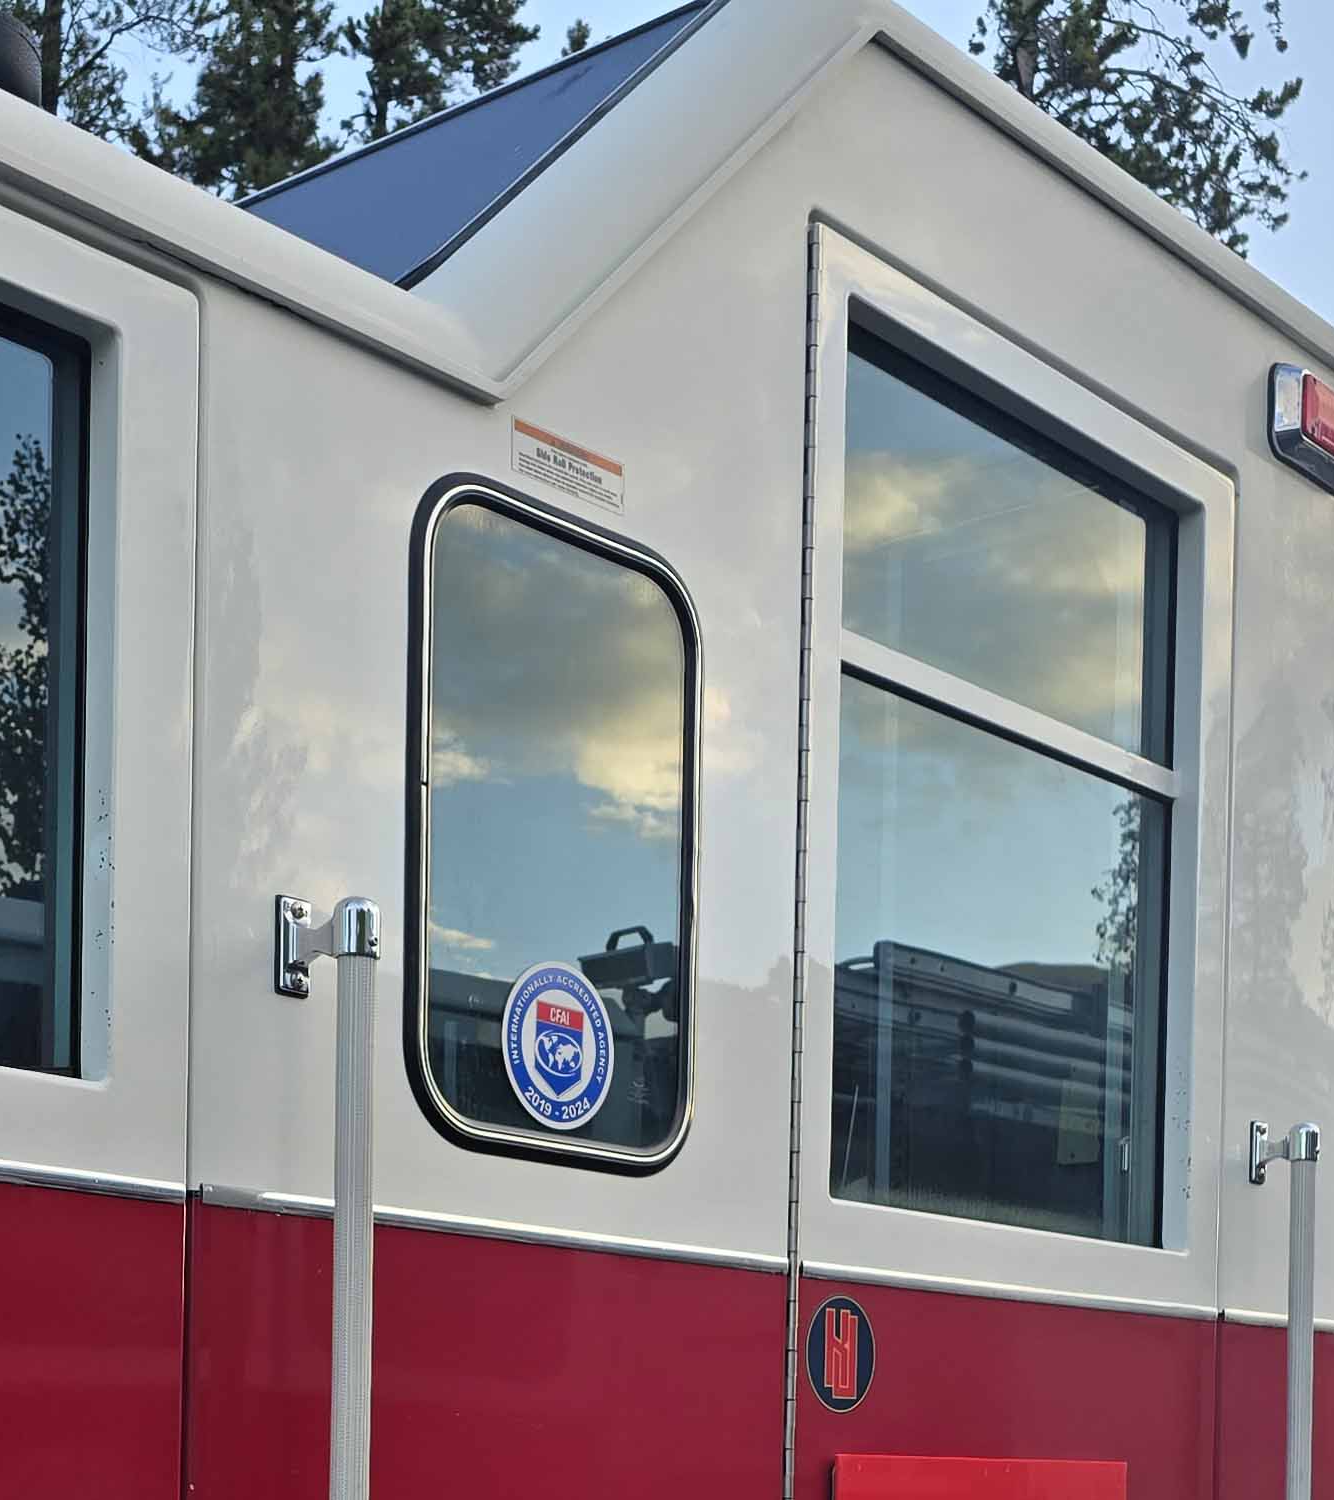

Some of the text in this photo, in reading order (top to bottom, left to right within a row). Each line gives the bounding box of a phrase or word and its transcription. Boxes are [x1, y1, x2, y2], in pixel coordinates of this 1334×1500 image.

[568, 462, 602, 485] Protection
[509, 975, 607, 1083] INTERNATIONALLY ACCREDITED AGENCY
[550, 1007, 570, 1026] CFAI
[524, 1086, 552, 1116] 2019
[562, 1097, 590, 1119] 2024
